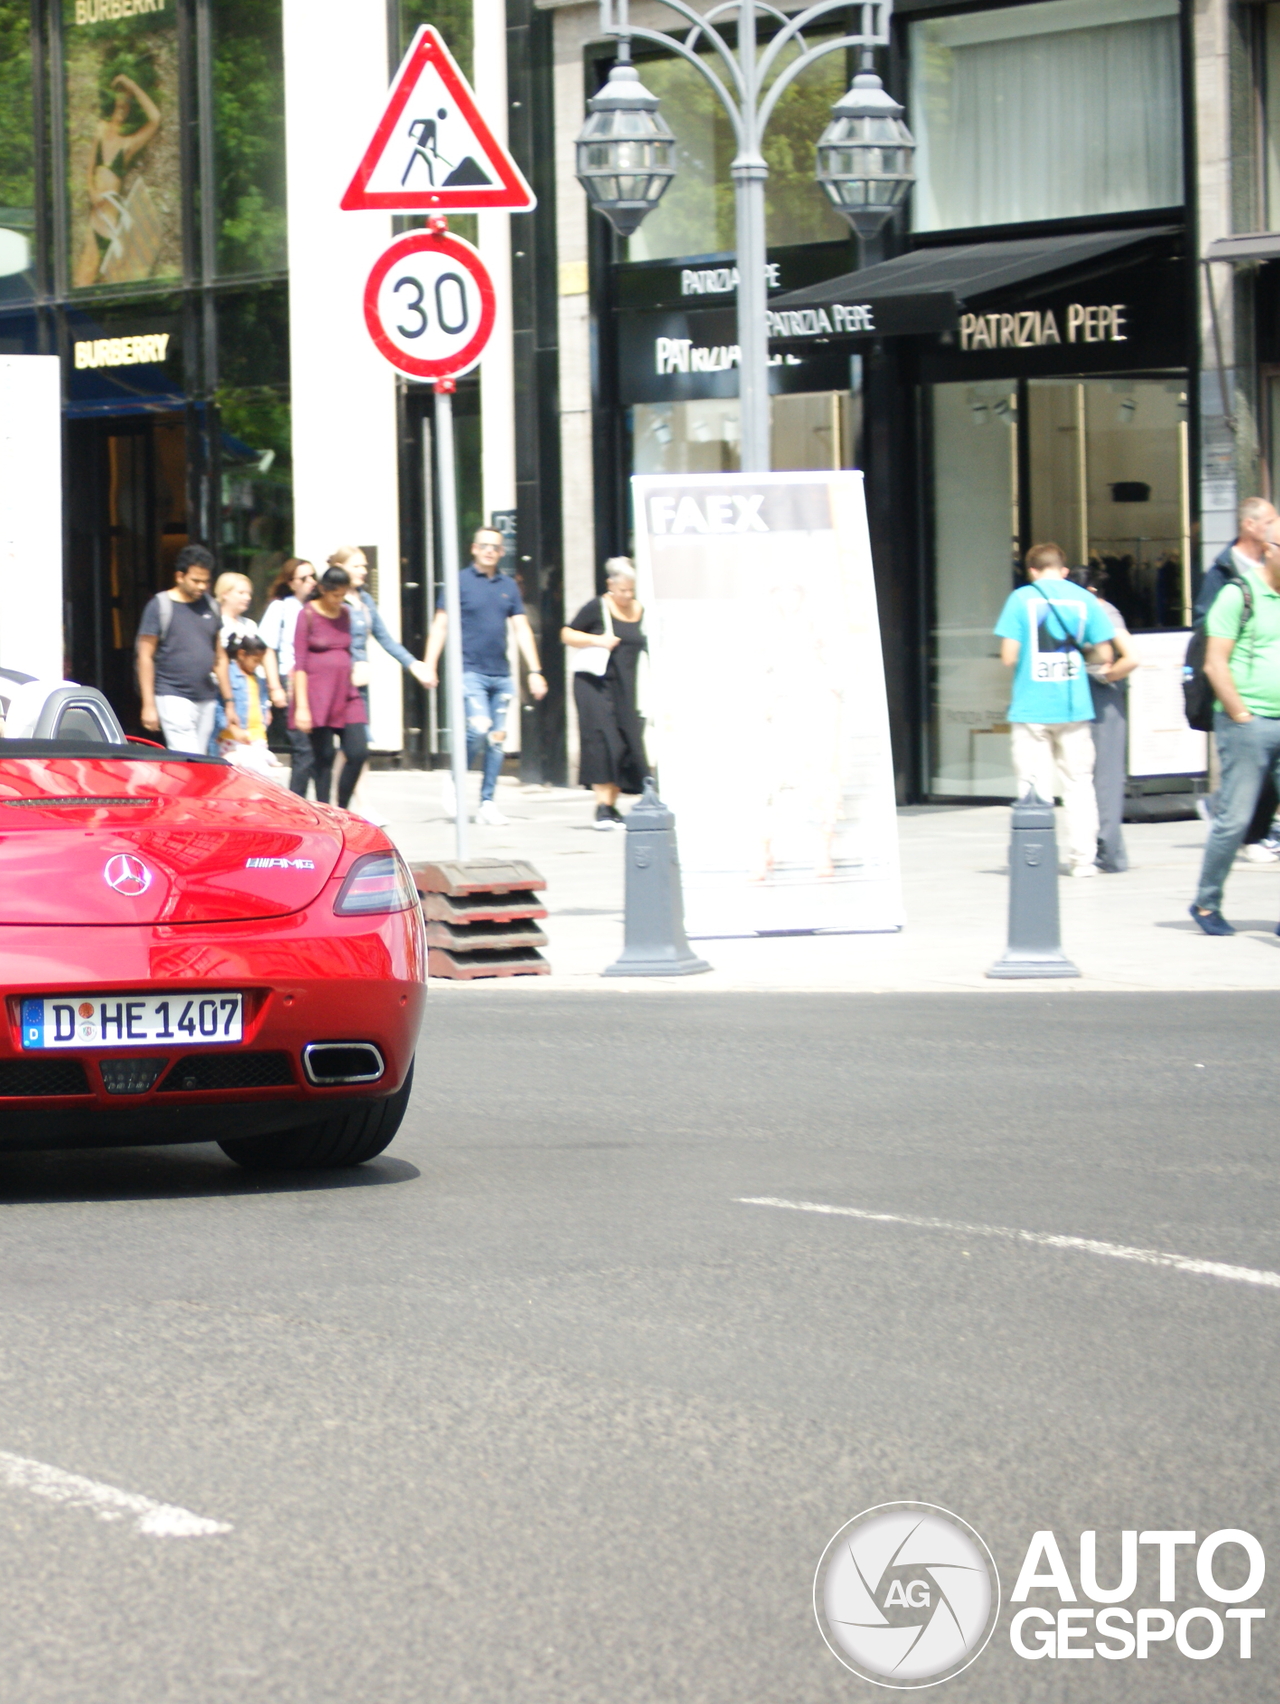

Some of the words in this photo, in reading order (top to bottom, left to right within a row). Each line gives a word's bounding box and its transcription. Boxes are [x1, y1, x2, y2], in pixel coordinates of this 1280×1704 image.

[681, 267, 741, 295] PATRIZIA
[393, 272, 469, 339] 30
[832, 304, 876, 332] PEPE
[961, 308, 1061, 350] PATRIZIA
[1067, 303, 1128, 344] PEPE
[74, 333, 170, 370] BURBERRY
[650, 494, 771, 535] FAEX
[52, 1004, 76, 1042] D
